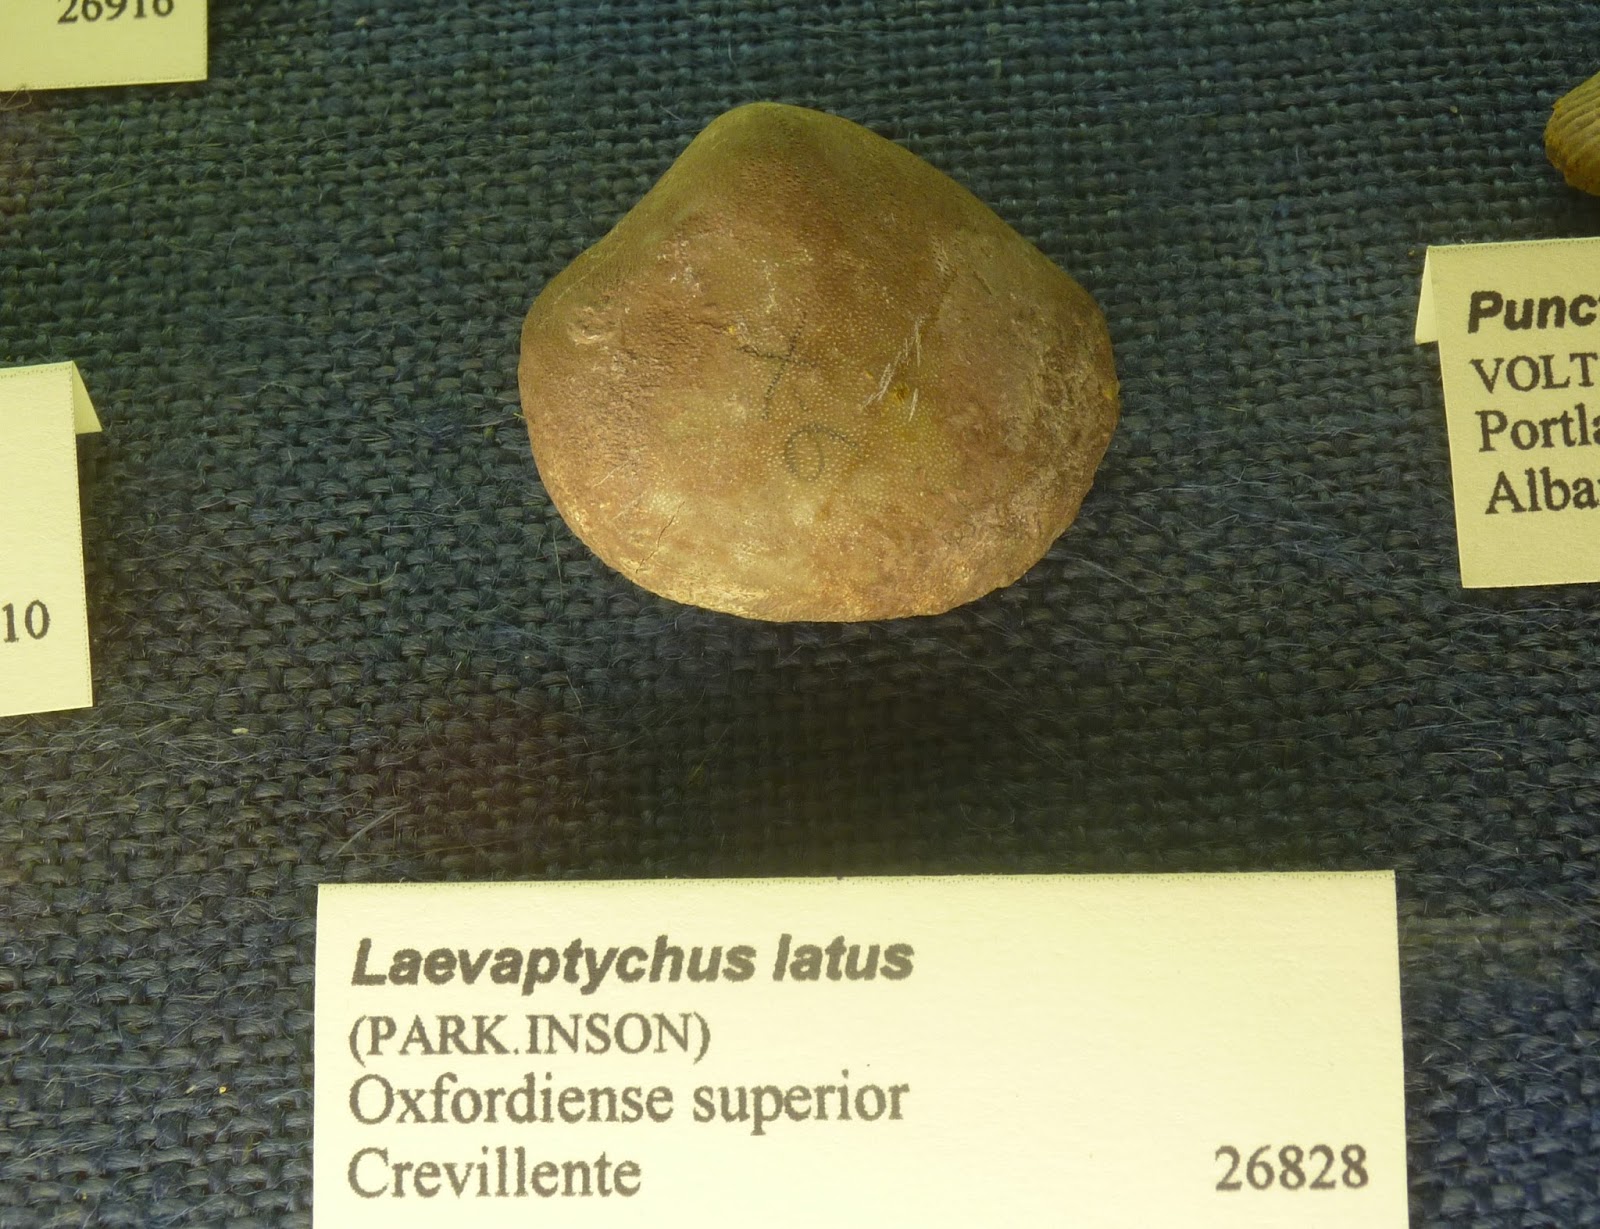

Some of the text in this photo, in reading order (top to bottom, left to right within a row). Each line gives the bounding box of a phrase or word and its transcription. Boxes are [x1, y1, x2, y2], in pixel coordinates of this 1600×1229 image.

[1467, 290, 1600, 334] Punc
[1469, 351, 1599, 394] VOLT
[1475, 402, 1600, 453] Portl
[1485, 466, 1600, 515] Alba
[2, 599, 50, 643] 10
[351, 934, 914, 995] Laevaptychus latus
[348, 1012, 711, 1066] (PARK.INSON)
[348, 1069, 910, 1135] Oxfordiense superior
[347, 1146, 642, 1198] Crevillente
[1214, 1144, 1369, 1191] 26828
